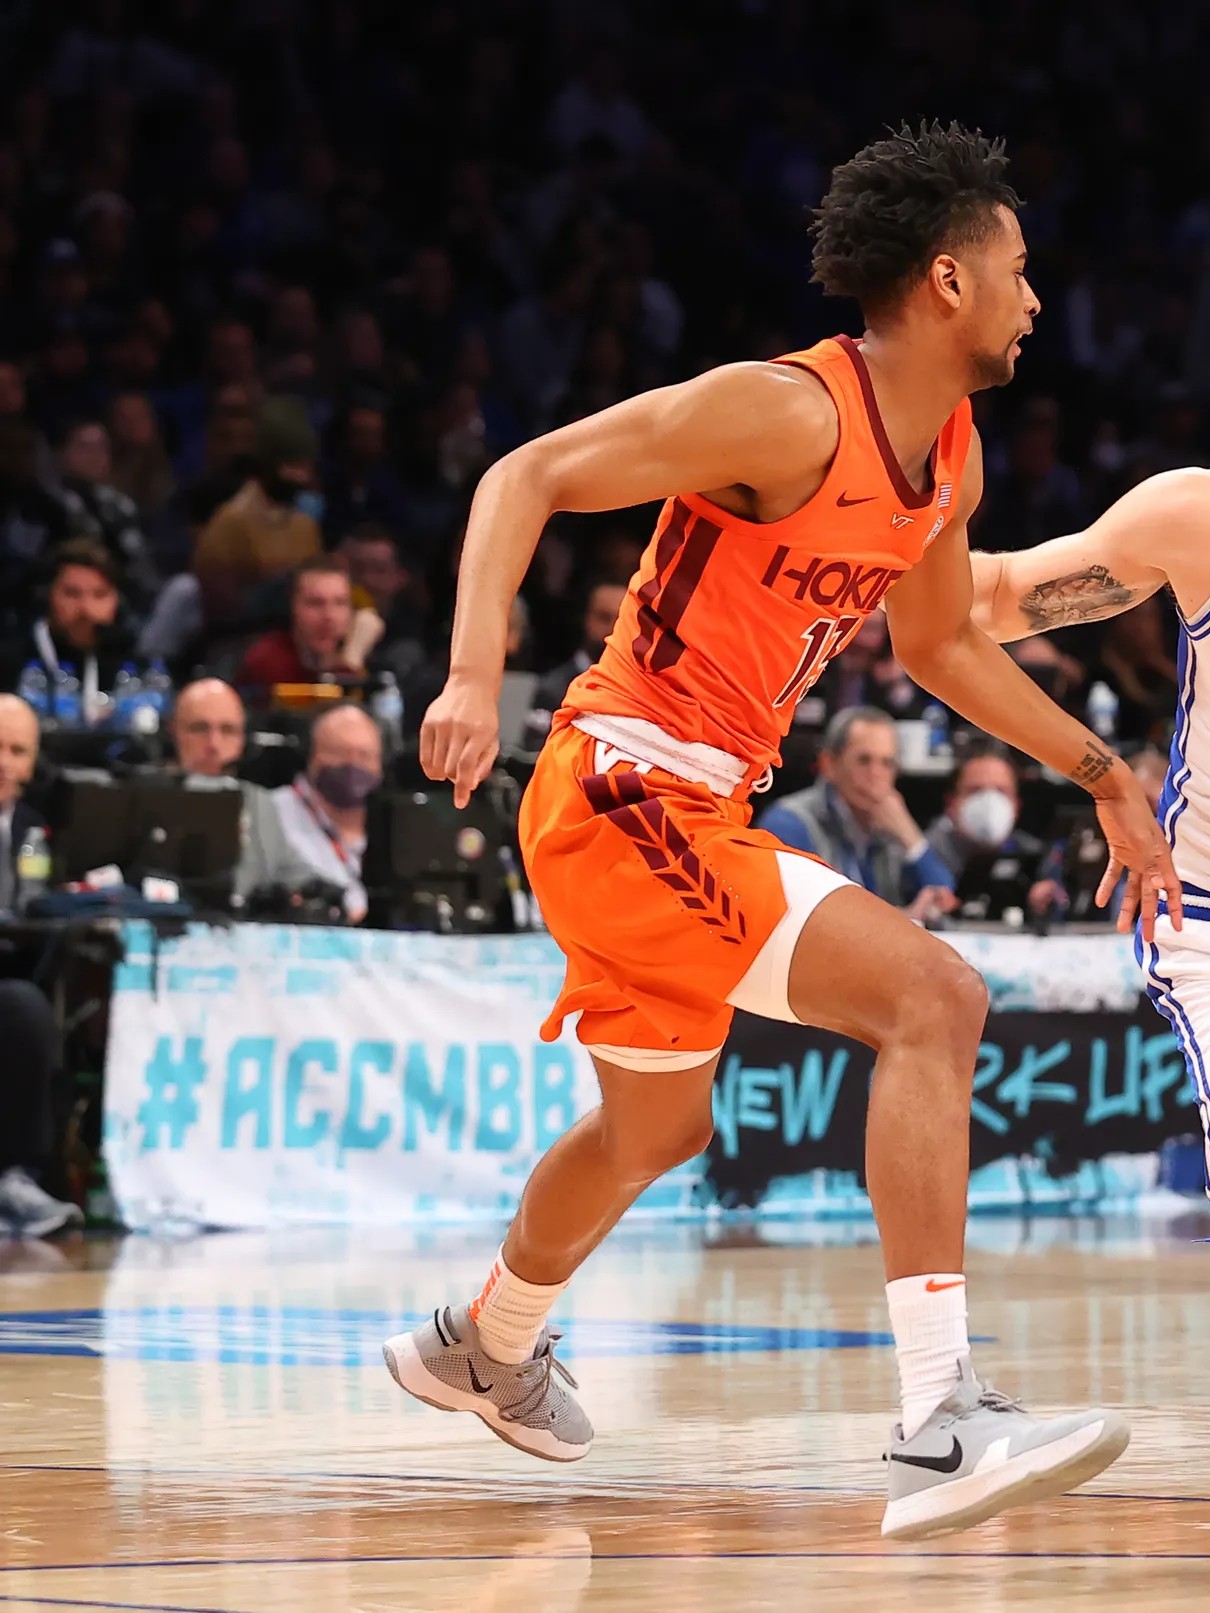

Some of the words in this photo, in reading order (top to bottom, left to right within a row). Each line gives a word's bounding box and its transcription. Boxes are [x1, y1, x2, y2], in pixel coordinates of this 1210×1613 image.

[891, 513, 915, 530] VT
[137, 1036, 575, 1151] #ACCMBB
[711, 1048, 850, 1159] NEW
